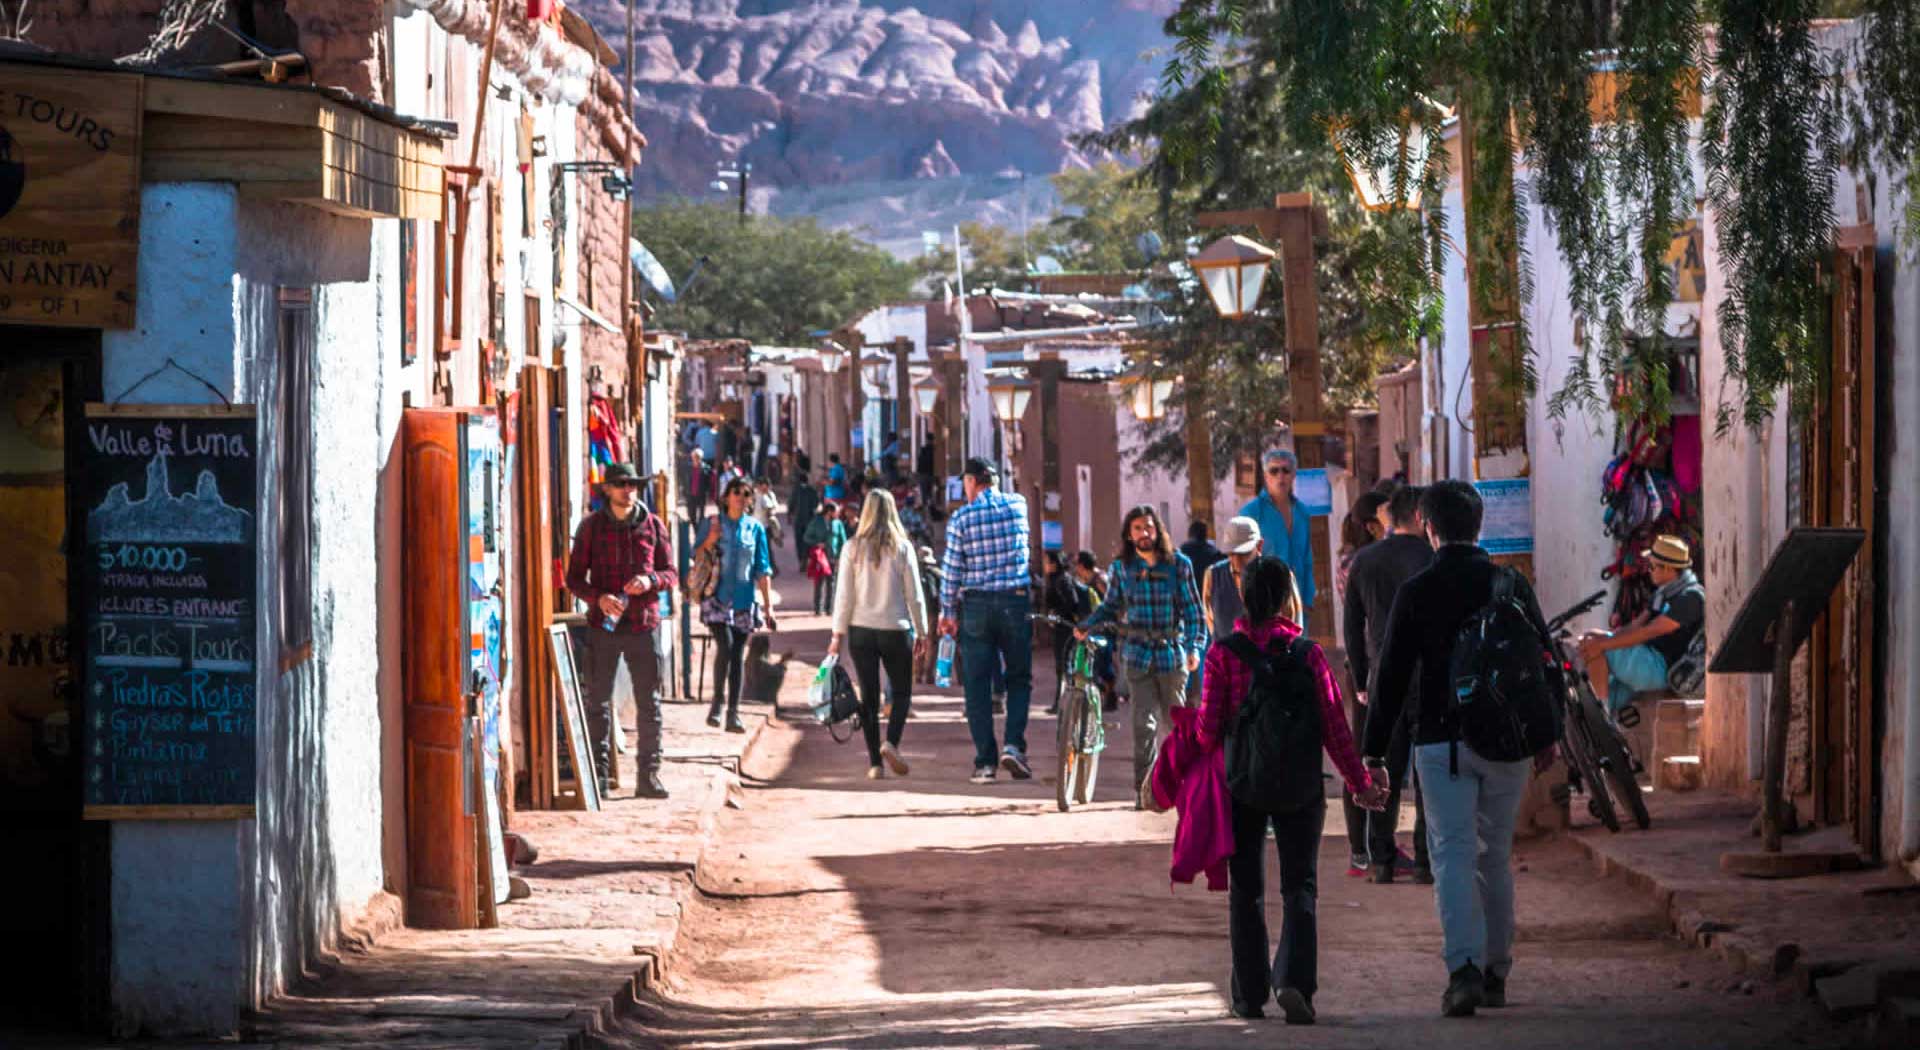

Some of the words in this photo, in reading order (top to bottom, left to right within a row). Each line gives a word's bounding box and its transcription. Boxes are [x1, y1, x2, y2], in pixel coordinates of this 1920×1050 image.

[15, 93, 115, 151] TOURS
[22, 261, 113, 288] ANTAY
[87, 422, 152, 457] Valle
[180, 422, 249, 458] Luna
[96, 621, 178, 657] Packs
[176, 622, 252, 661] Tours
